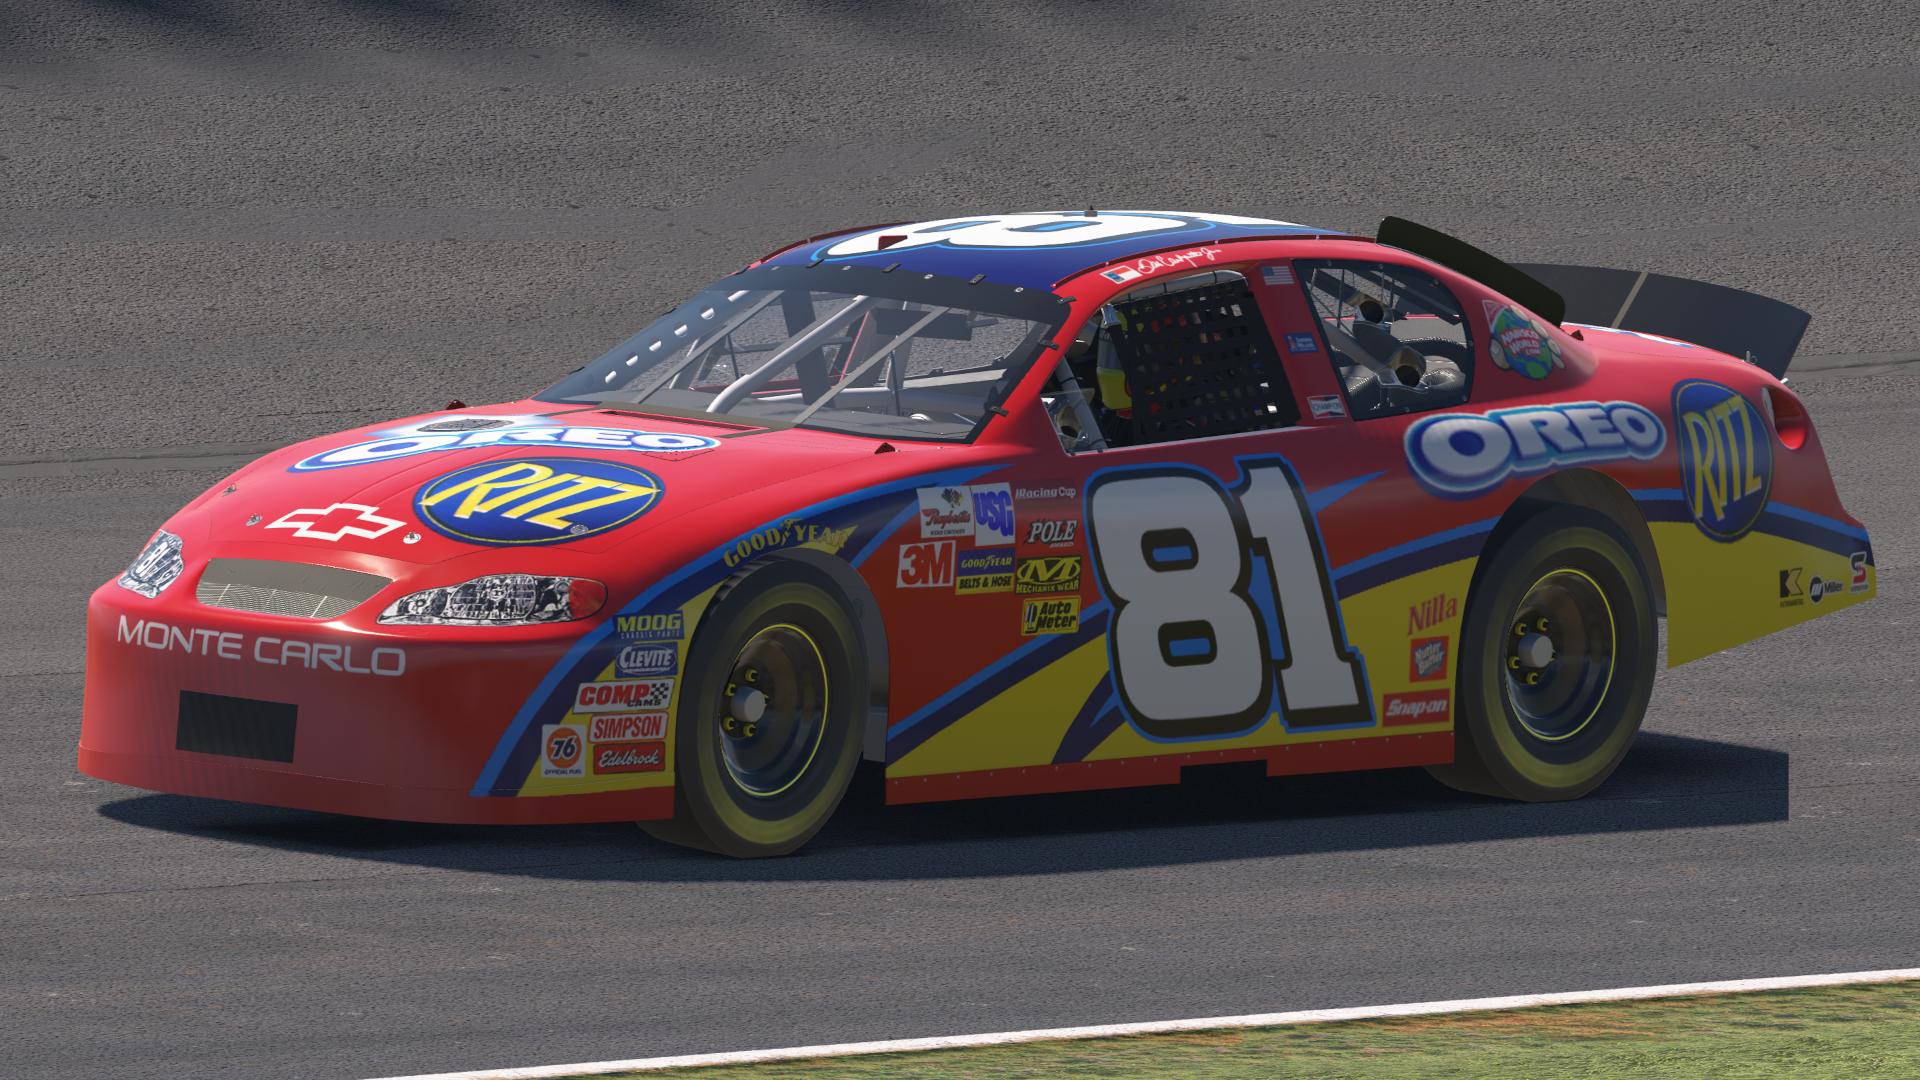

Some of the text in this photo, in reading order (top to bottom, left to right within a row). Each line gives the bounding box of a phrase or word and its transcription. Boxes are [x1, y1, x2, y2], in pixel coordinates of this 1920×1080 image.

[290, 427, 722, 470] OREO
[1420, 403, 1663, 480] OREO
[1695, 394, 1762, 521] RITZ
[418, 462, 660, 530] RITZ
[1059, 486, 1077, 498] Cup
[974, 490, 1014, 536] USG
[1028, 519, 1078, 543] POLE
[901, 542, 952, 585] 3M
[959, 575, 1012, 589] BELTS & HOSE
[1058, 580, 1079, 592] WEAR
[1090, 464, 1362, 723] 81
[1040, 601, 1072, 615] Auto
[1407, 594, 1458, 636] Nilla
[618, 613, 681, 632] MOOG
[1037, 615, 1076, 629] Meter
[117, 615, 407, 676] MONTE CARLO
[619, 646, 674, 667] CLEVITE
[579, 684, 650, 706] COMP
[626, 699, 661, 708] CAMS
[1386, 699, 1448, 718] Snap-on
[593, 716, 662, 739] SIMPSON
[551, 736, 577, 760] 76
[599, 749, 659, 768] Edelbrock
